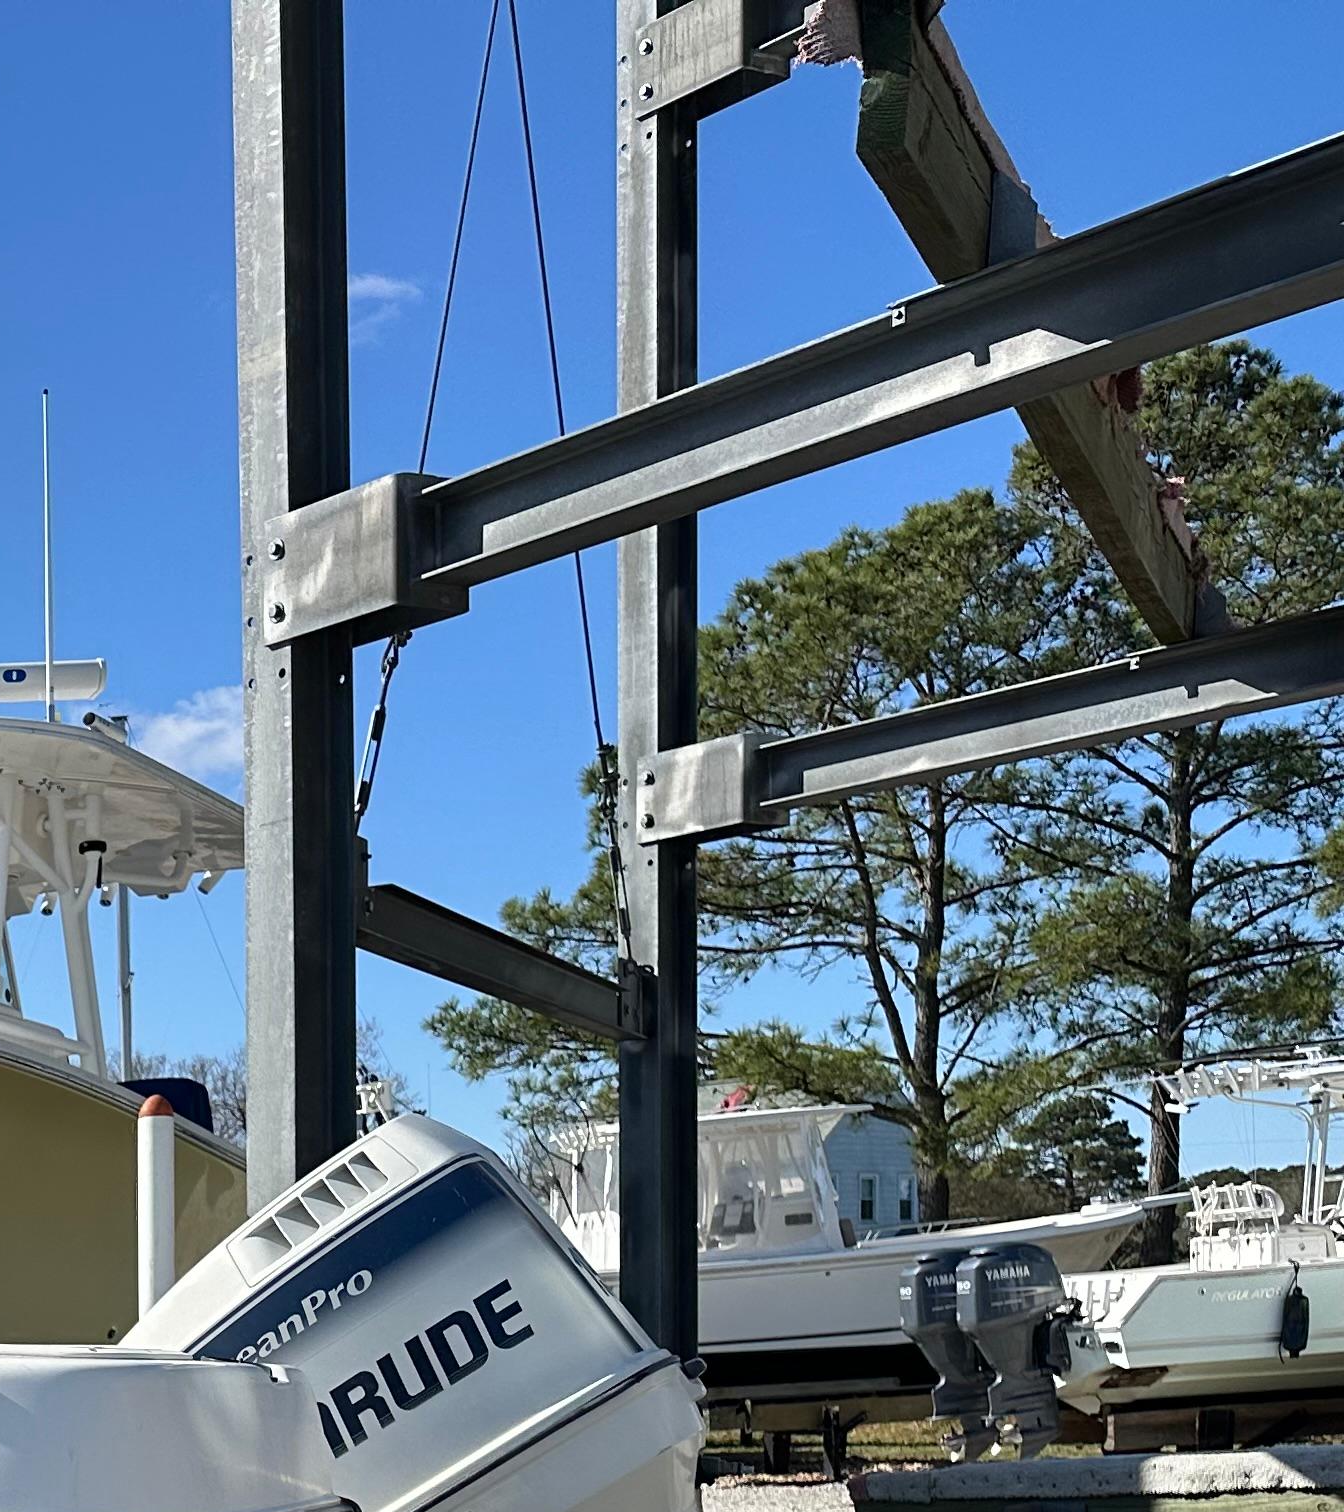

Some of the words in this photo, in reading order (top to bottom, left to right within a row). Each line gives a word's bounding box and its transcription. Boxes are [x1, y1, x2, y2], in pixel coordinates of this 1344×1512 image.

[925, 1273, 956, 1288] YAMA
[985, 1264, 1031, 1281] YAMAHA
[235, 1269, 373, 1364] eanPro
